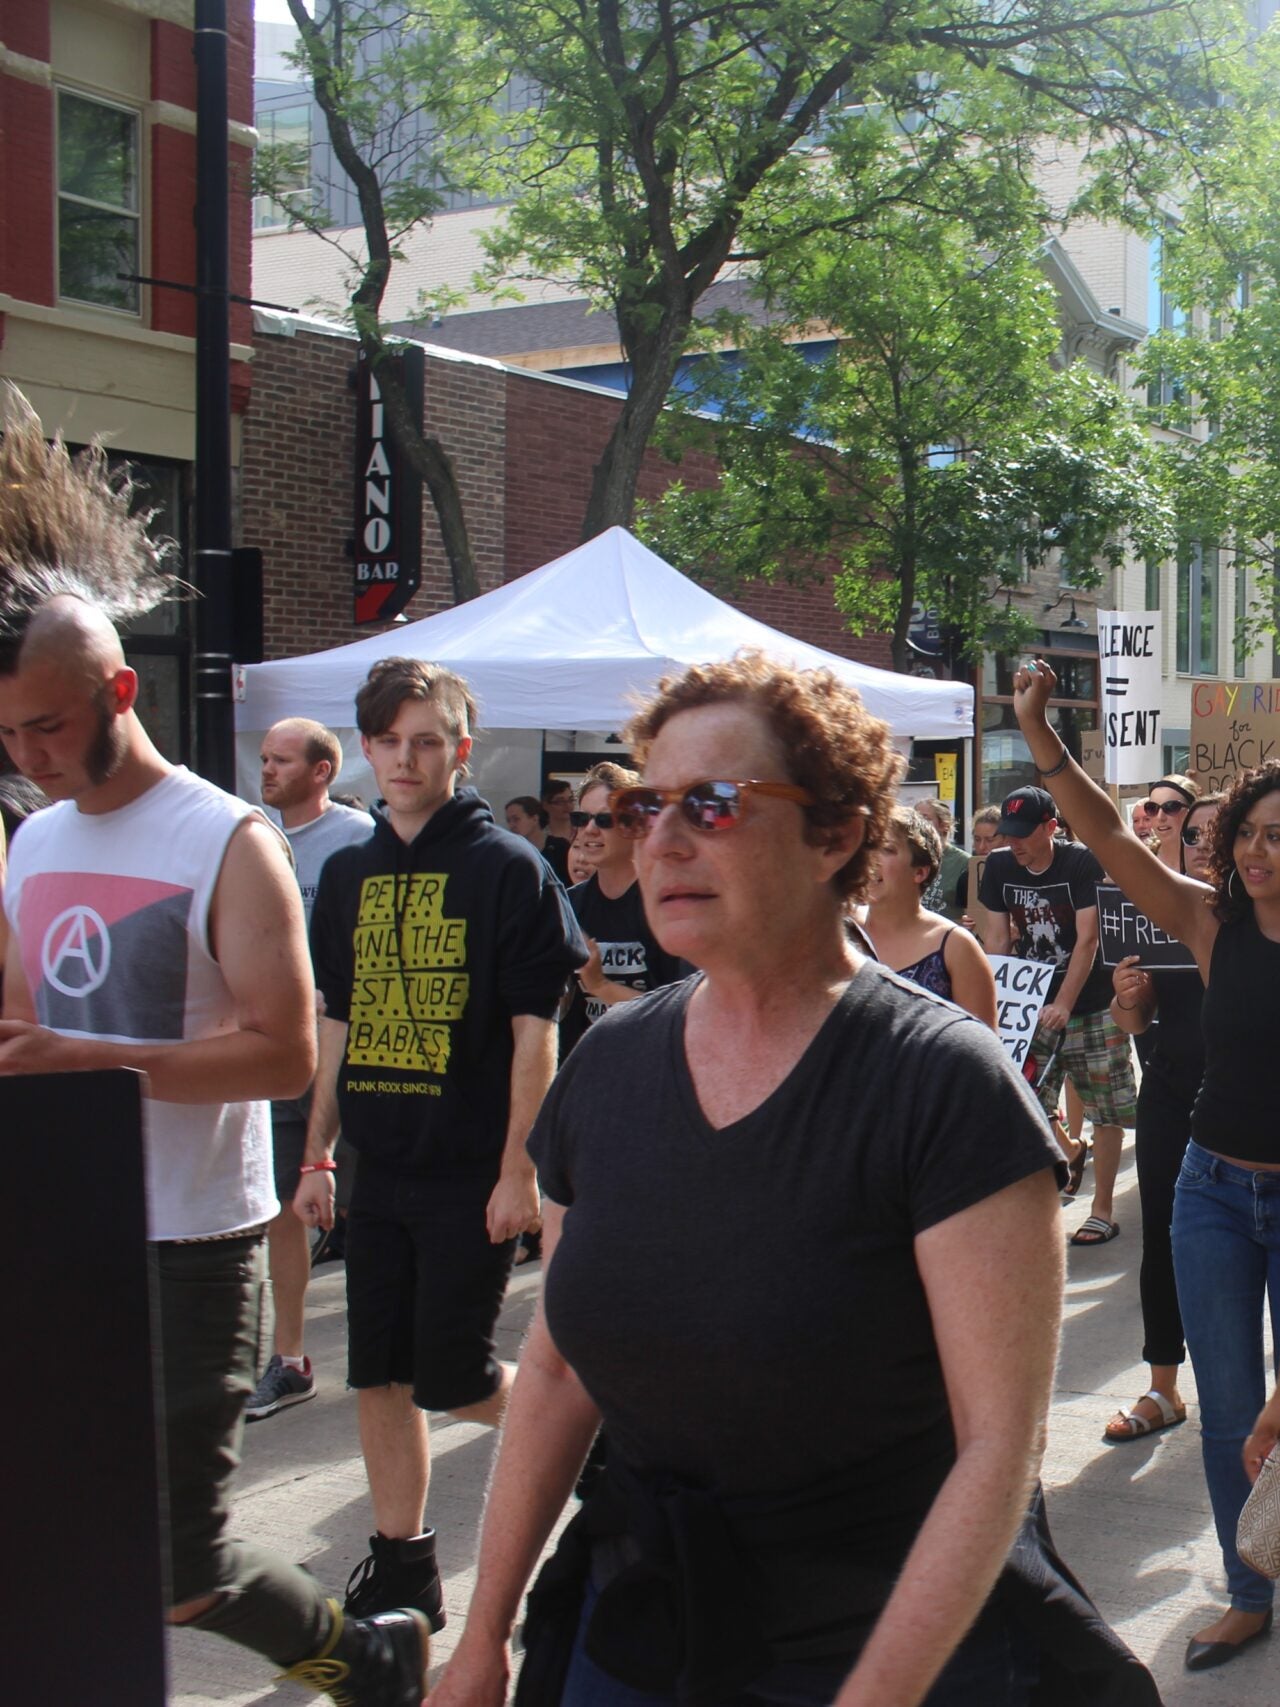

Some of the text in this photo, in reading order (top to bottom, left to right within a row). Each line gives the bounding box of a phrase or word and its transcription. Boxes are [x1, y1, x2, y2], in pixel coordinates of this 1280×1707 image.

[357, 562, 399, 580] BAR
[1194, 683, 1239, 717] GAY
[1229, 720, 1251, 741] for
[1196, 739, 1275, 773] BLACK
[363, 879, 440, 909] PETER
[412, 924, 462, 954] THE
[602, 948, 643, 966] ACK
[402, 976, 467, 1006] TUBE
[354, 1022, 445, 1057] BABIES
[347, 1081, 377, 1092] PUNK
[378, 1082, 401, 1093] ROCK
[402, 1083, 428, 1094] SINCE
